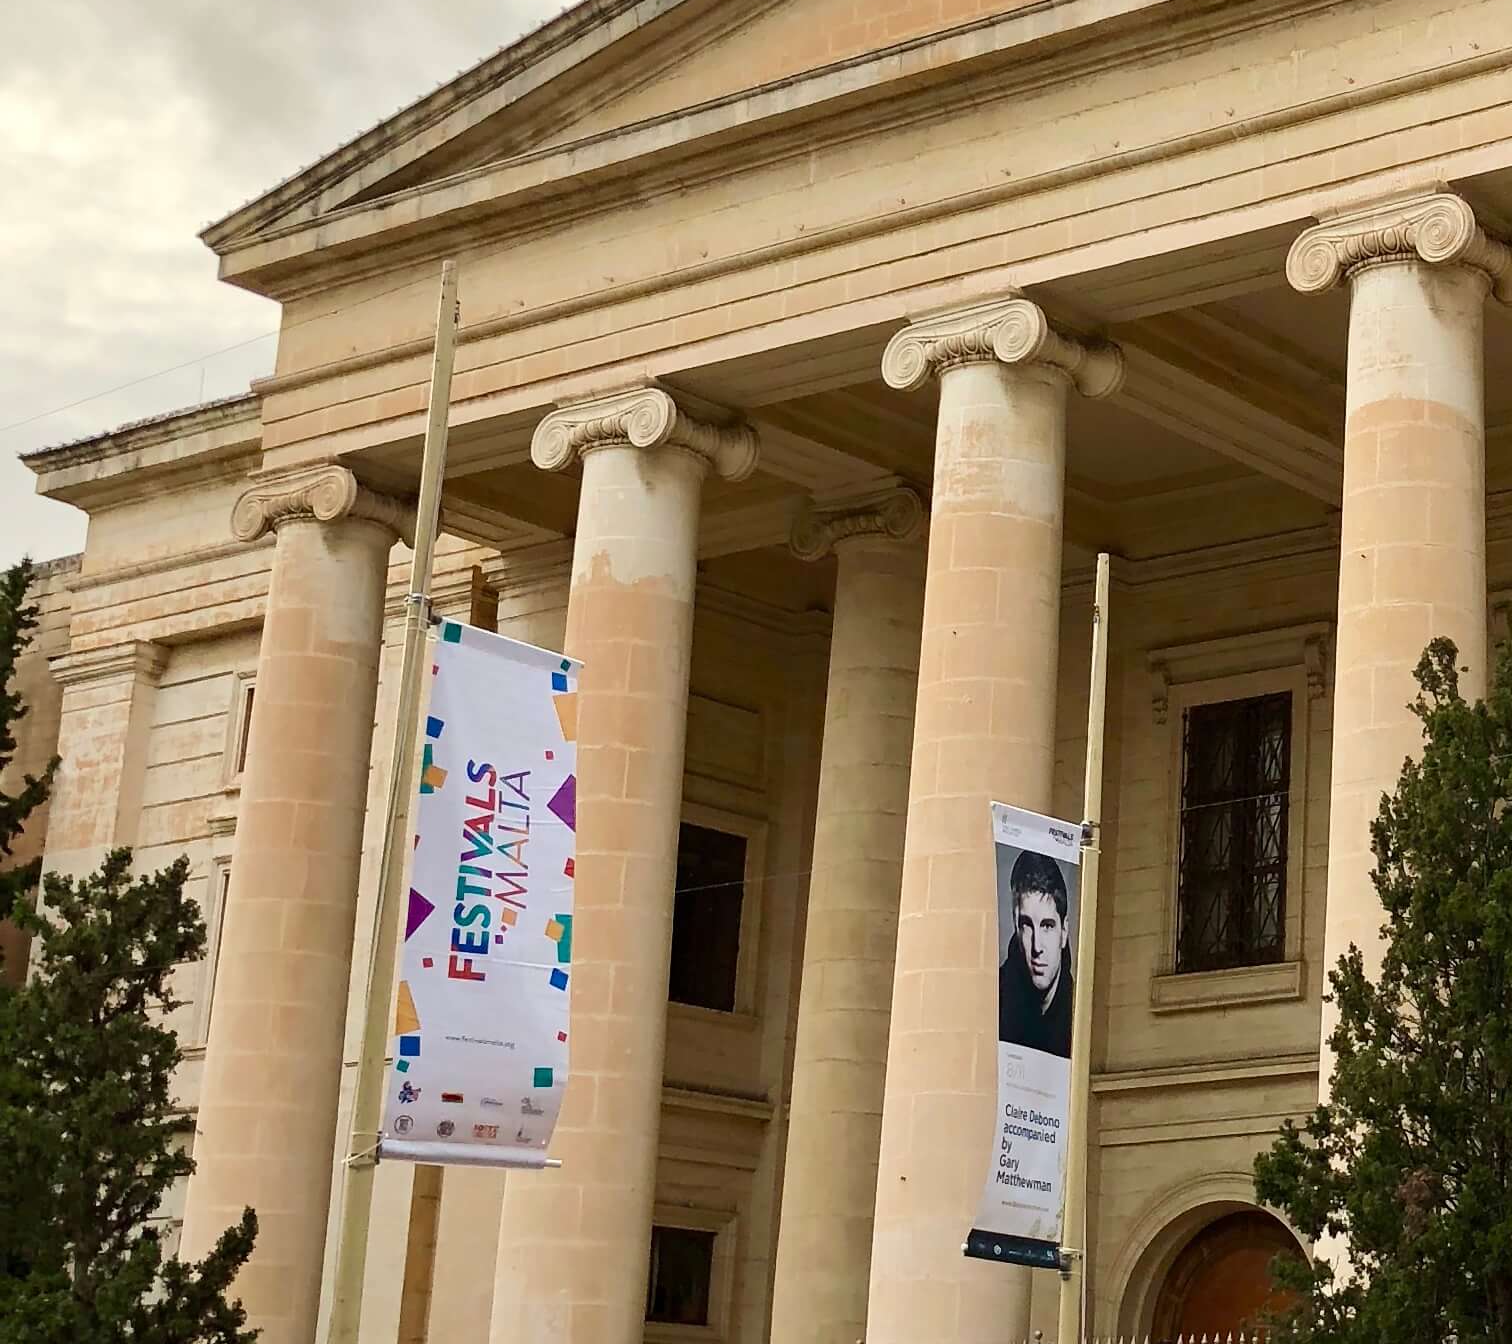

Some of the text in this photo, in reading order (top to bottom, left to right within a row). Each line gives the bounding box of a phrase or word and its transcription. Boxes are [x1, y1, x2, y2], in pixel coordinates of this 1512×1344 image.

[495, 770, 531, 909] MALTA
[448, 759, 497, 982] FESTIVALS
[1005, 1103, 1060, 1129] Claire Debono
[1003, 1122, 1056, 1144] accompanied
[1001, 1136, 1012, 1153] by
[999, 1154, 1019, 1172] Gary
[996, 1171, 1052, 1193] Matthewman
